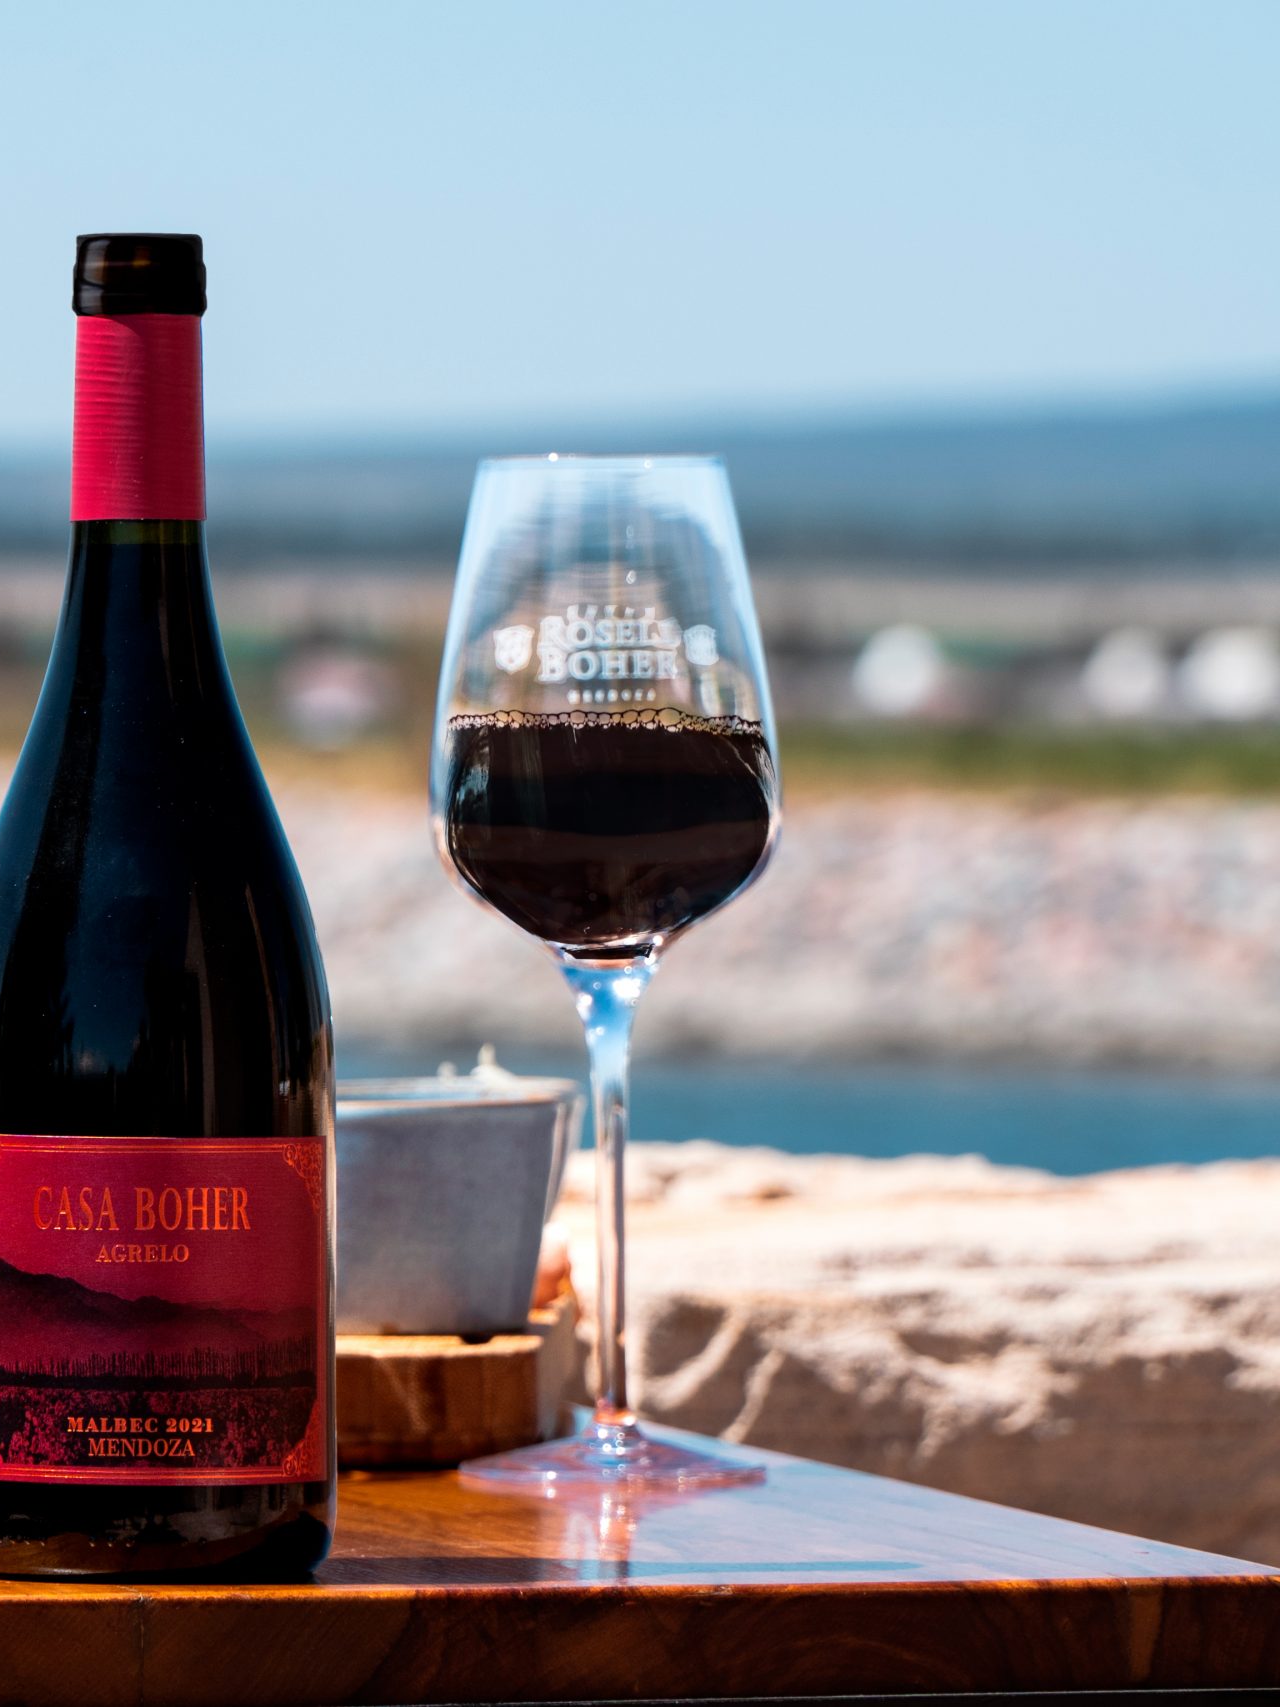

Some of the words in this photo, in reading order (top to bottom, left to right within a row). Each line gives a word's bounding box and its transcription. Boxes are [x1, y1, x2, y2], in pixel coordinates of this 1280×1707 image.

[536, 648, 677, 683] BOHER
[34, 1186, 119, 1231] CASA
[135, 1186, 251, 1231] BOHER
[95, 1245, 189, 1263] AGRELO
[67, 1416, 158, 1433] MALBEC
[166, 1417, 214, 1433] 2021
[88, 1437, 195, 1457] MENDOZA
